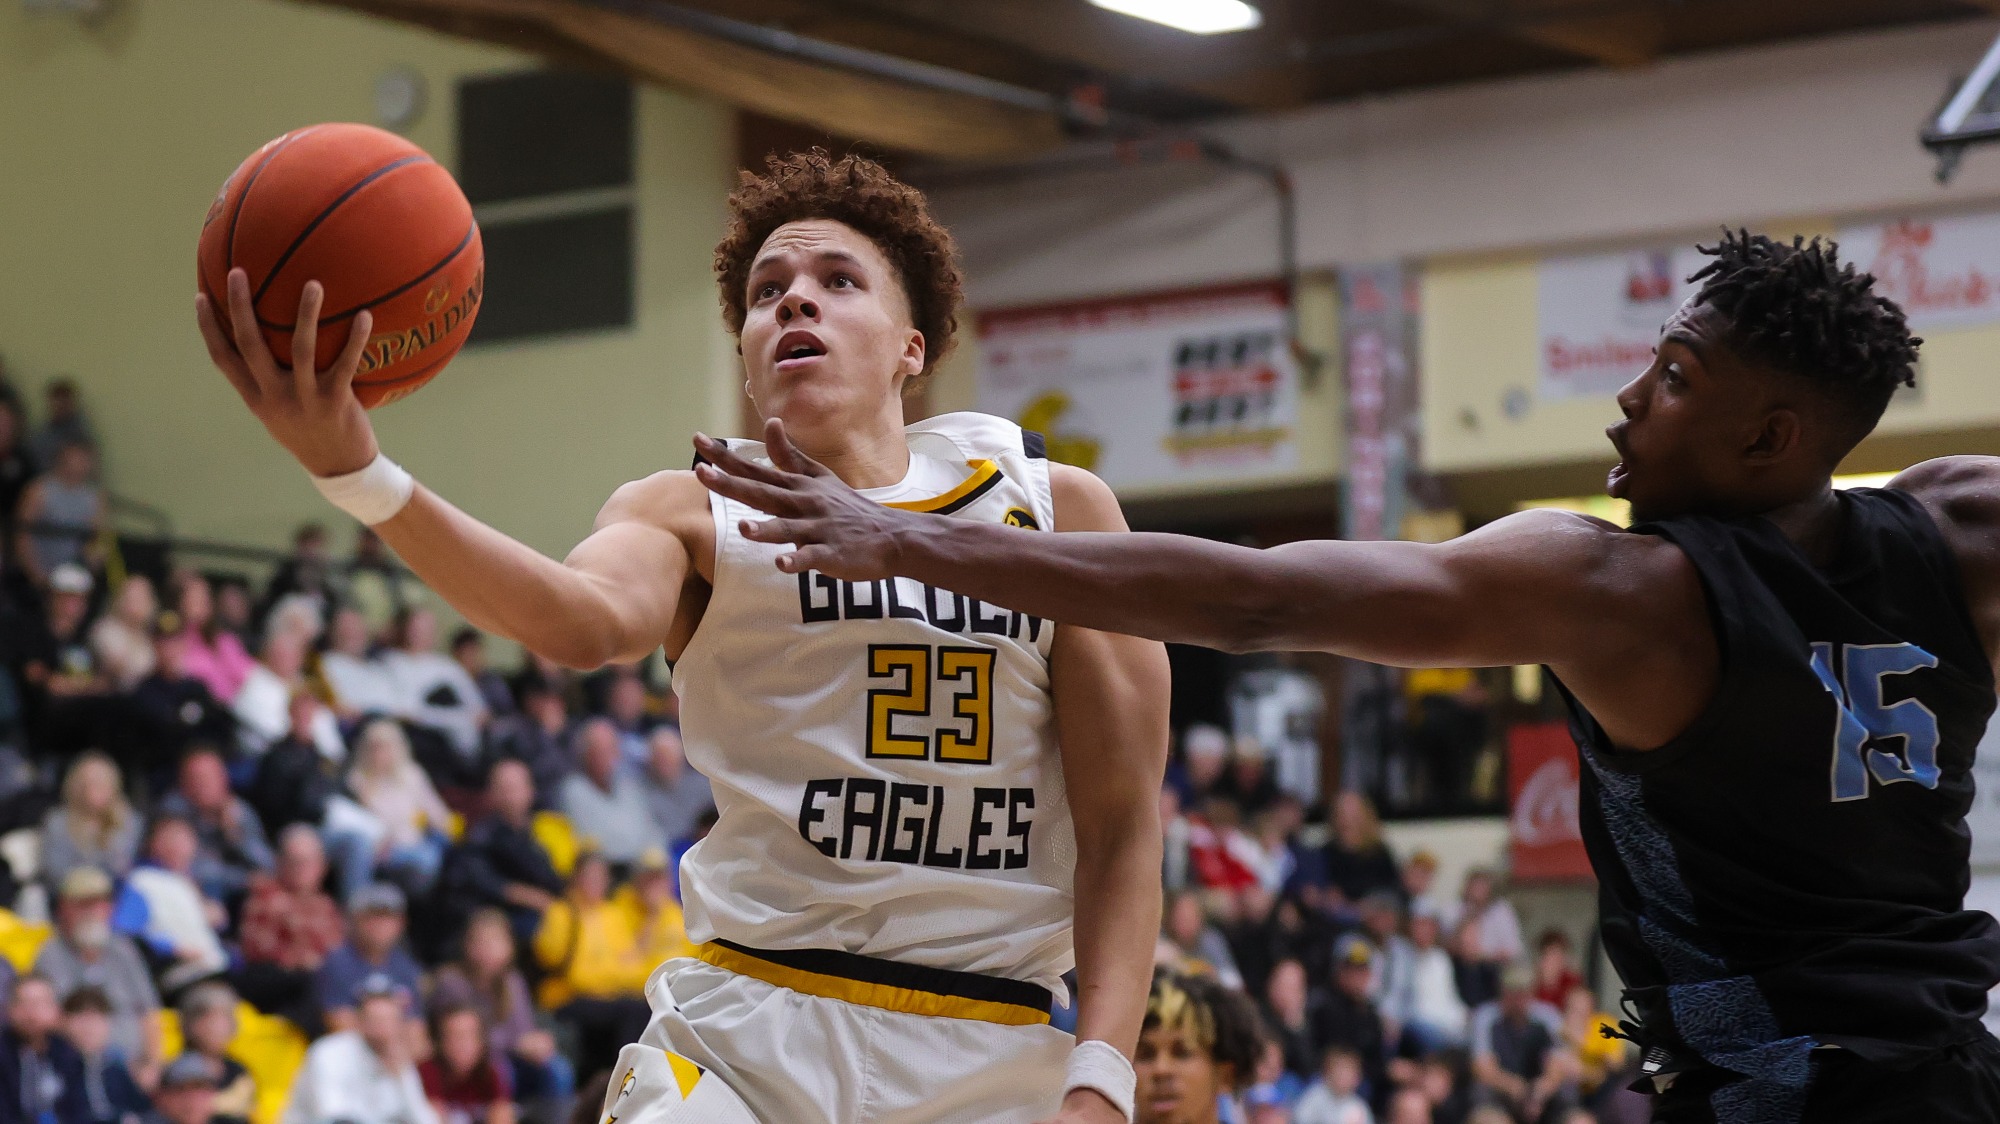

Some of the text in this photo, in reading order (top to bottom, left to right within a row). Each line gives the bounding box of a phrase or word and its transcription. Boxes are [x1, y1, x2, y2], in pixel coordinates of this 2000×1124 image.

[866, 644, 997, 765] 23
[1809, 641, 1940, 802] 15
[799, 778, 1035, 869] EAGLES
